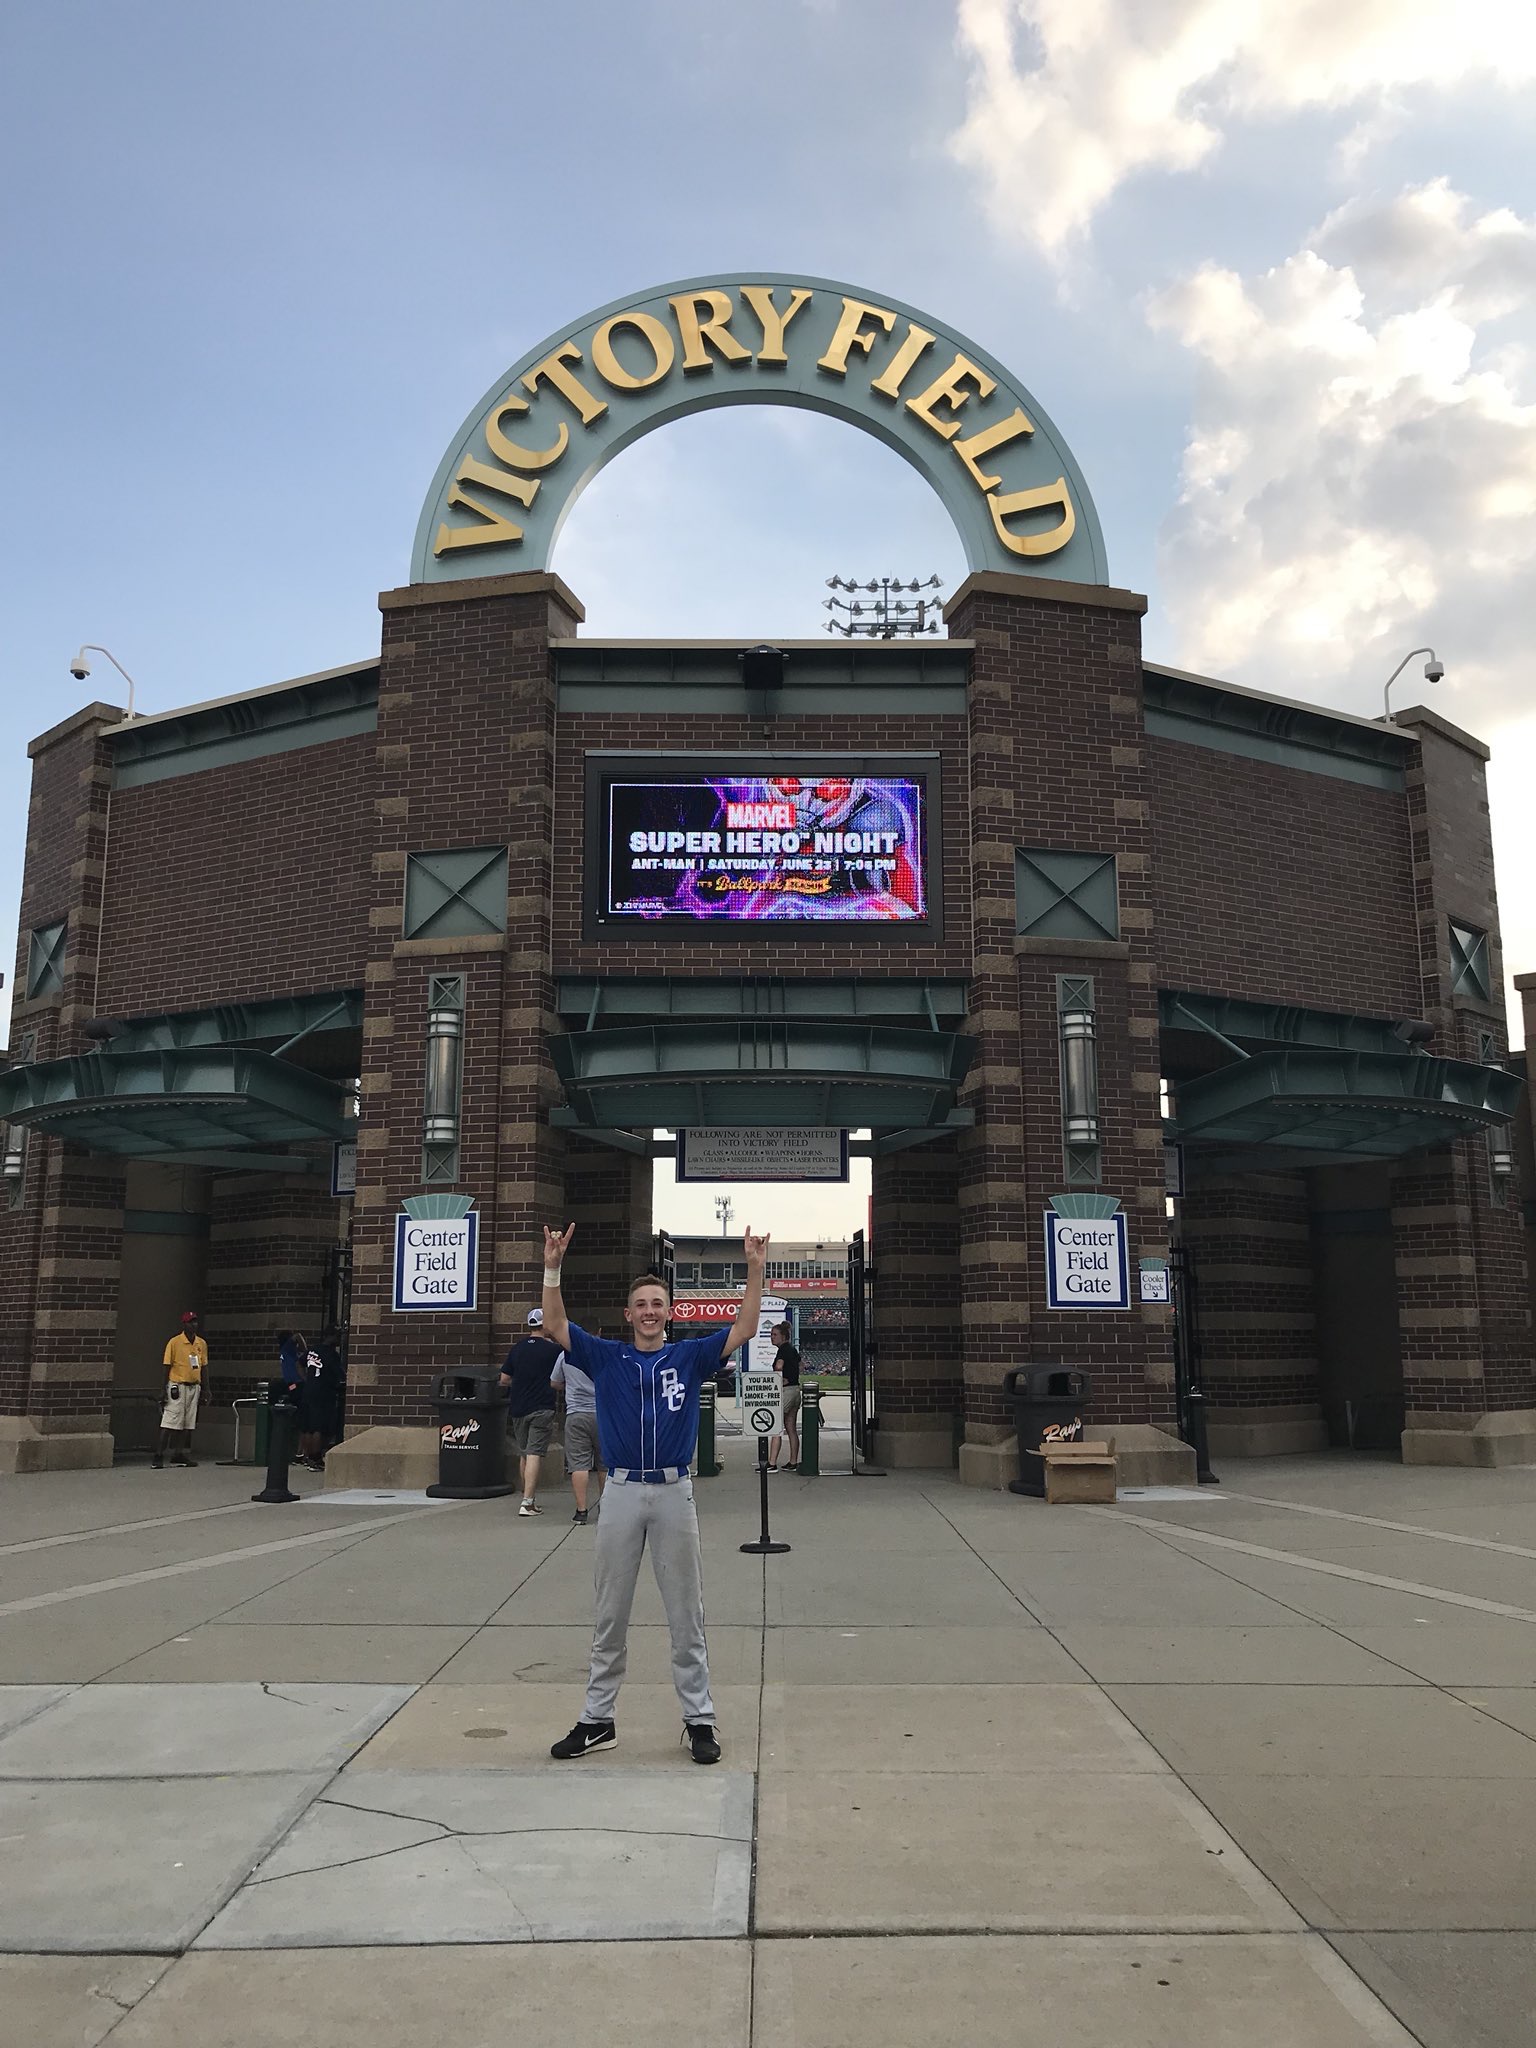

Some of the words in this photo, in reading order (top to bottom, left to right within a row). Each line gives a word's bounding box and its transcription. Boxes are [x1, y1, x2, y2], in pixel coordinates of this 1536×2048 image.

[434, 286, 812, 559] VICTORY
[817, 297, 1075, 559] FIELD
[727, 804, 796, 828] MARVEL
[629, 832, 721, 853] SUPER
[815, 832, 898, 853] NIGHT
[631, 859, 695, 870] ANT-MAN
[782, 859, 812, 870] JUNE
[875, 859, 896, 870] PM
[689, 1130, 740, 1139] FOLLOWING
[743, 1130, 762, 1139] ARE
[766, 1130, 784, 1139] NOT
[787, 1130, 837, 1139] PERMITTED
[718, 1139, 740, 1147] INTO
[743, 1139, 778, 1147] VICTORY
[783, 1139, 809, 1147] FIELD
[407, 1229, 466, 1247] Center
[1057, 1227, 1115, 1246] Center
[414, 1252, 457, 1271] Field
[1066, 1251, 1109, 1270] Field
[412, 1276, 458, 1294] Gate
[1065, 1274, 1111, 1293] Gate
[1142, 1275, 1164, 1283] Cooler
[698, 1304, 741, 1316] TOYO
[441, 1418, 480, 1448] Ray's
[1043, 1416, 1082, 1443] Ray's
